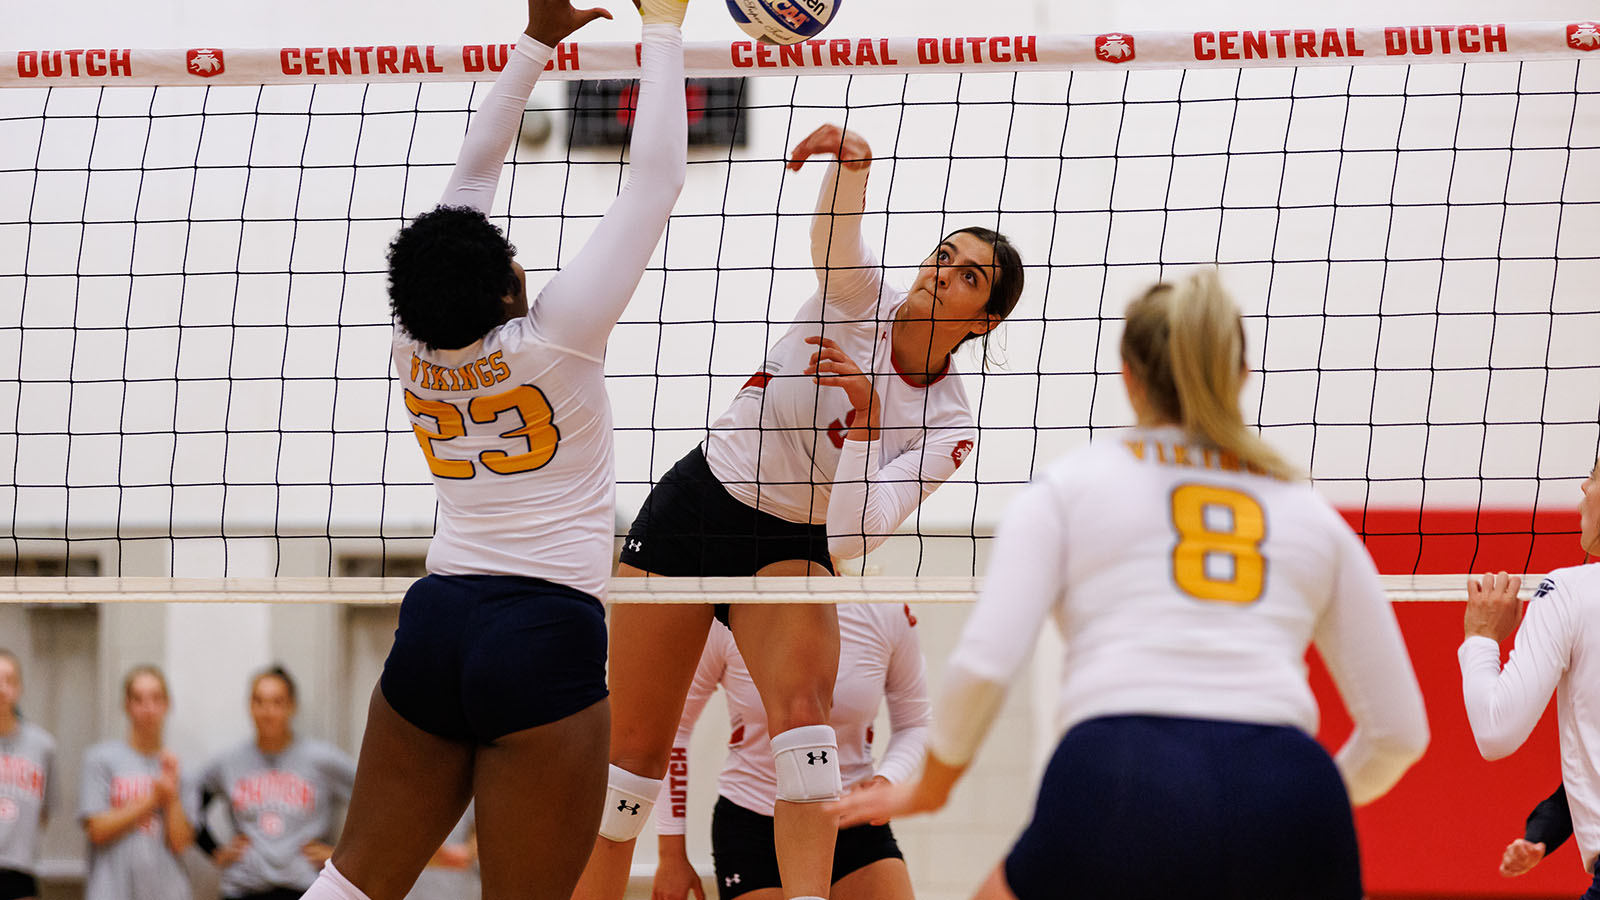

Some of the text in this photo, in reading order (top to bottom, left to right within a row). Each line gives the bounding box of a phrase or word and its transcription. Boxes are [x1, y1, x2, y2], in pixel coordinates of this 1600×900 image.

[767, 0, 808, 30] CAA
[280, 42, 581, 76] CENTRAL DUH
[730, 35, 1038, 68] CENTRAL DUTCH
[1193, 24, 1508, 61] CENTRAL DUTCH
[17, 49, 132, 78] DUTCH
[410, 350, 511, 391] VIKINGS
[404, 384, 562, 480] 23
[1170, 482, 1270, 608] 8
[669, 747, 688, 818] DUTCH
